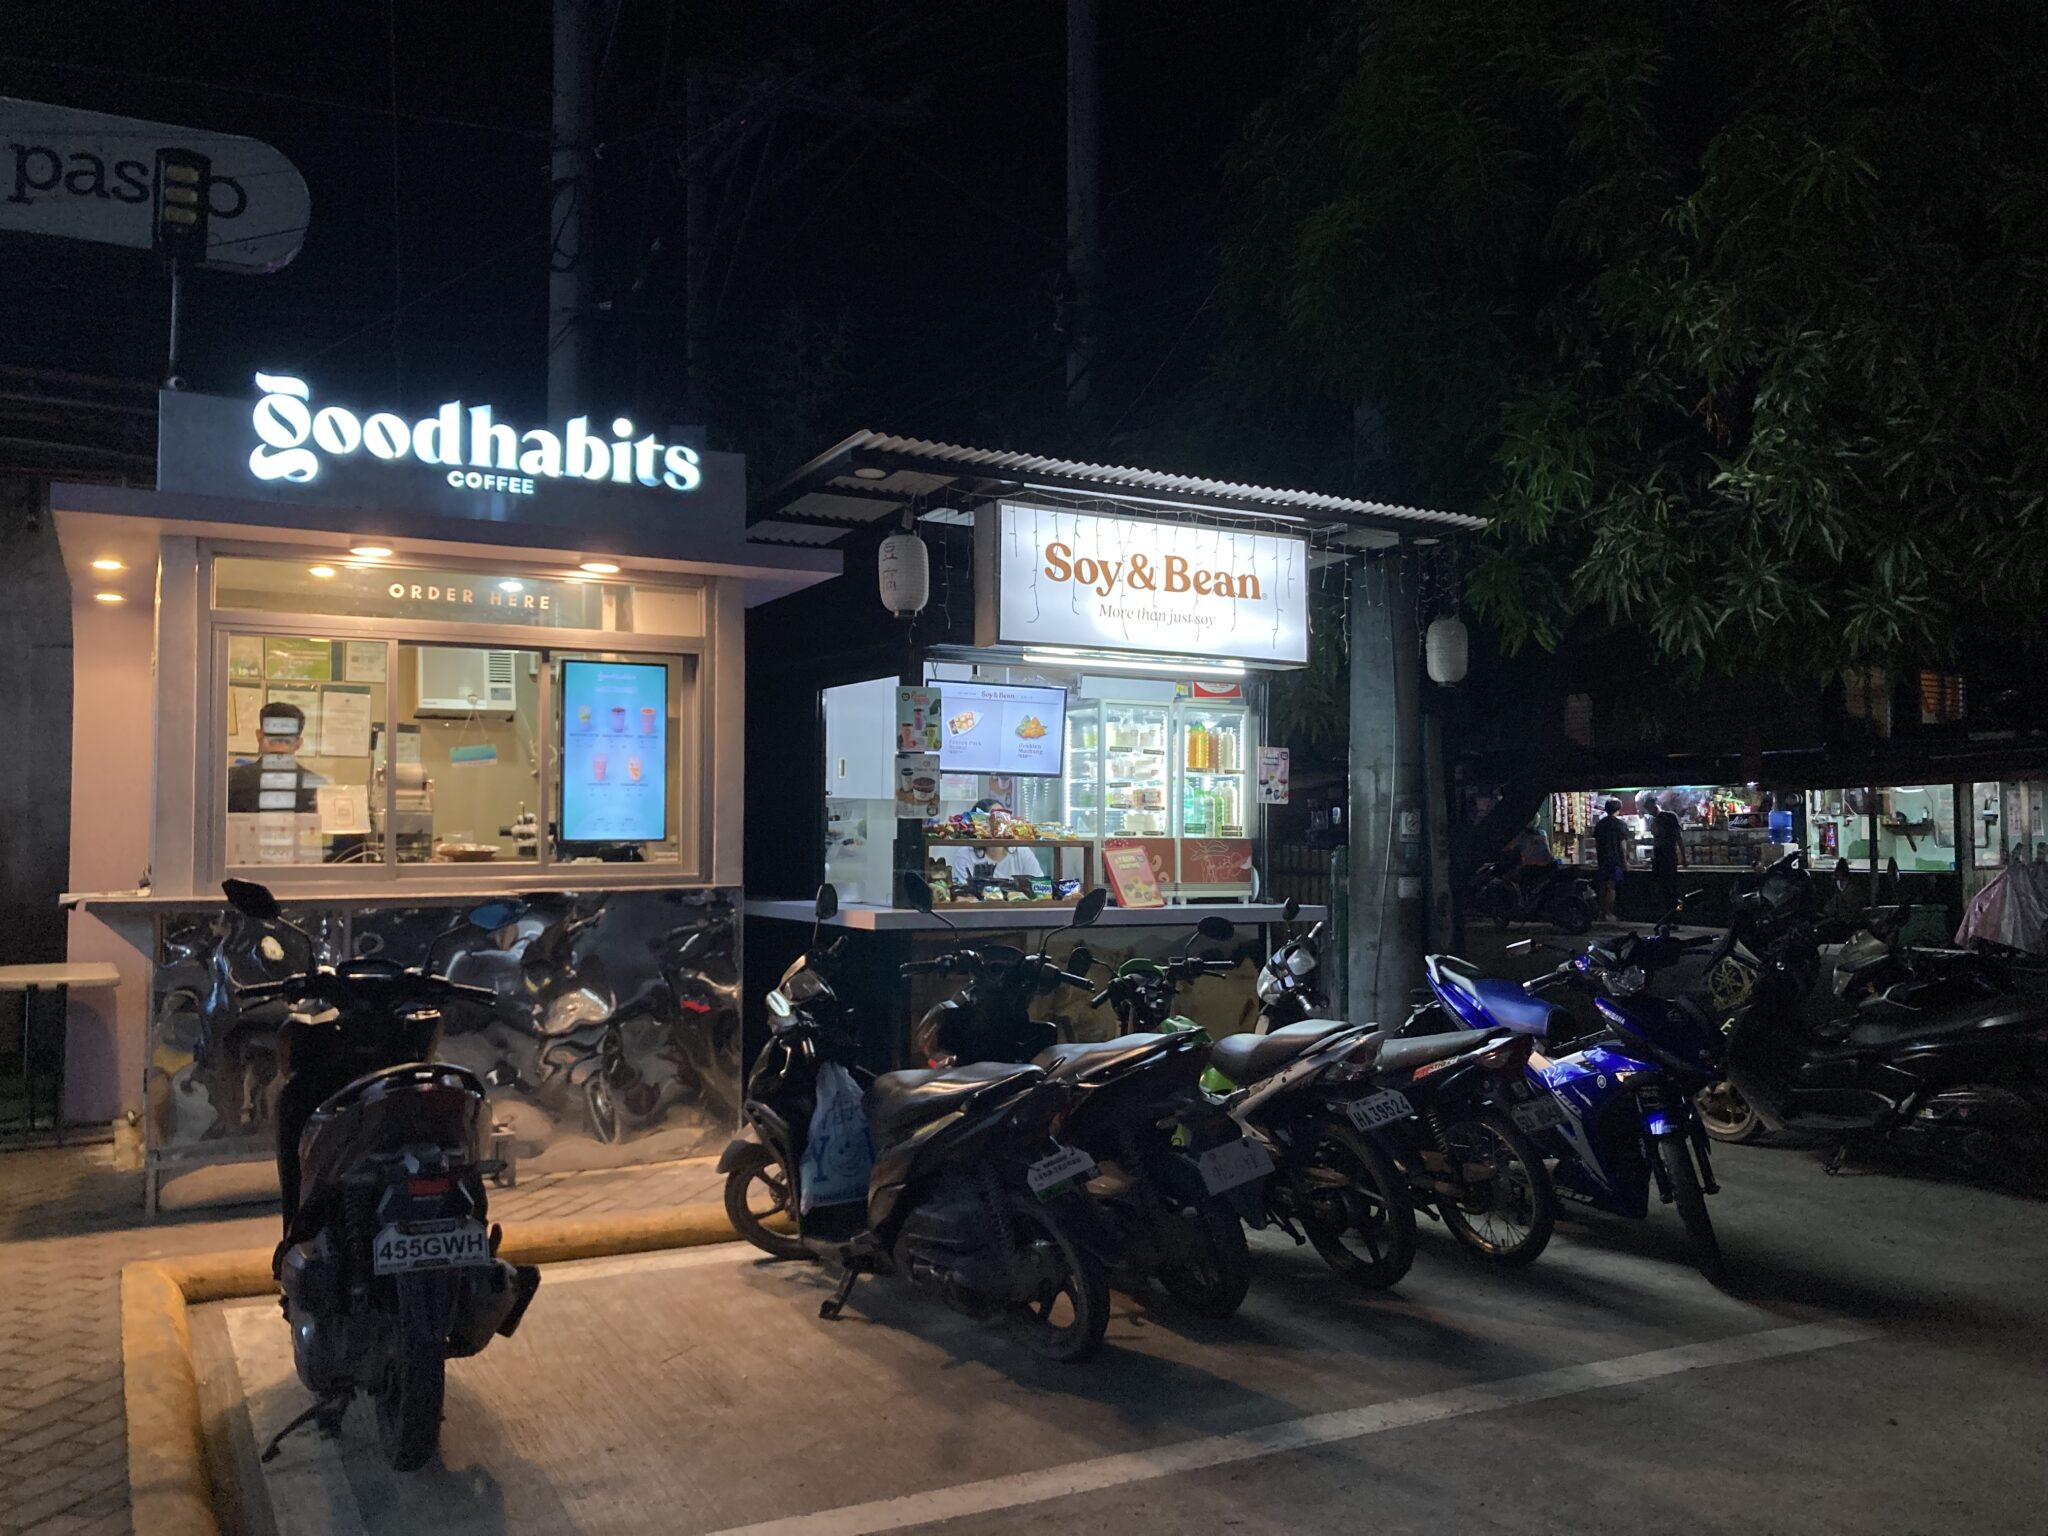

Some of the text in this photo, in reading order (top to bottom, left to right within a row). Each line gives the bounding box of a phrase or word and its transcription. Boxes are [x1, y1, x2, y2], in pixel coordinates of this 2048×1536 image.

[8, 143, 248, 219] paso
[447, 470, 534, 495] COFFEE
[388, 583, 550, 609] ORDER HERE
[1099, 603, 1216, 629] More than just soy
[379, 1233, 484, 1261] 455GWH
